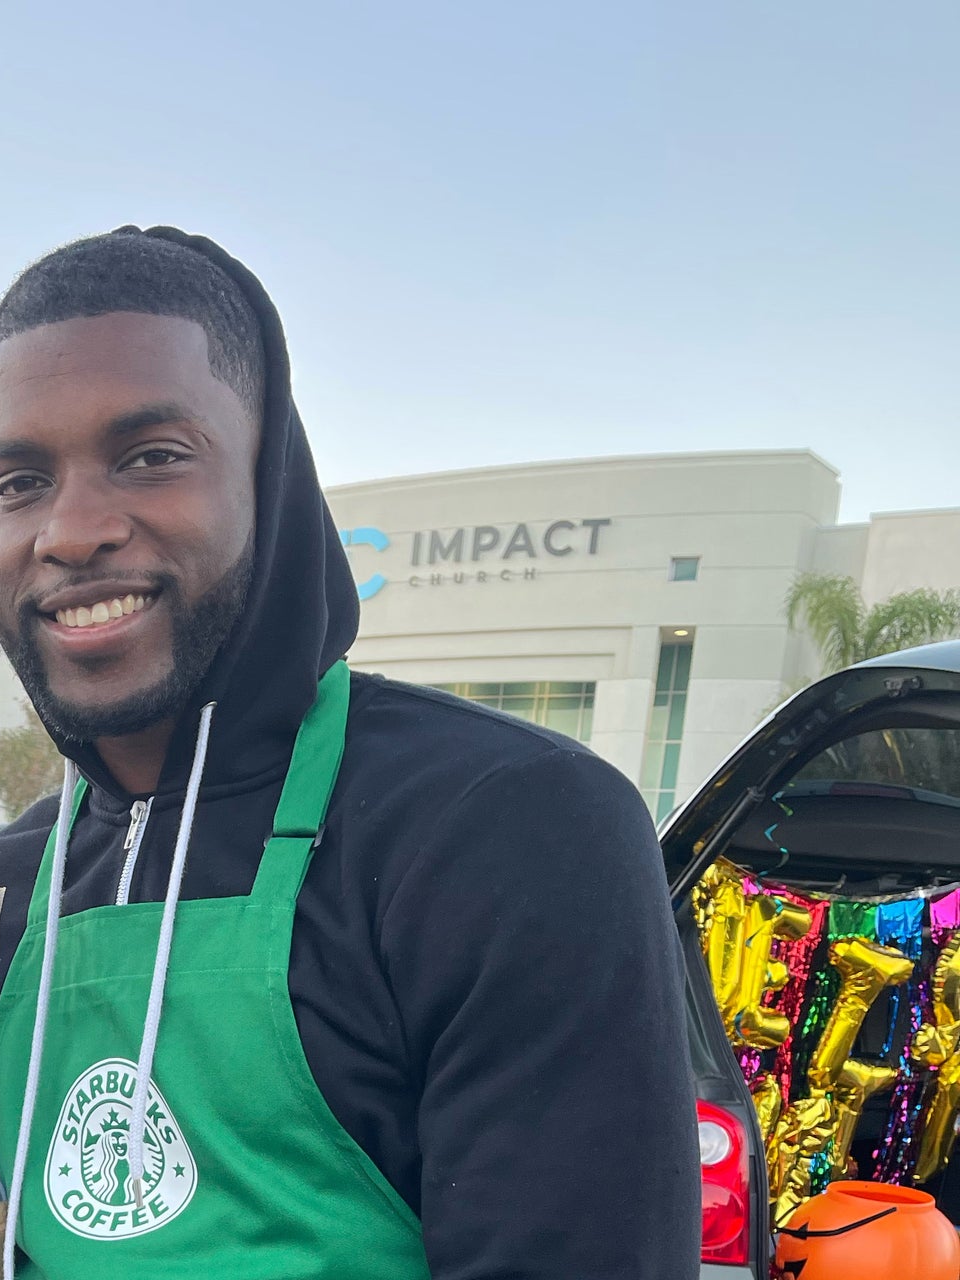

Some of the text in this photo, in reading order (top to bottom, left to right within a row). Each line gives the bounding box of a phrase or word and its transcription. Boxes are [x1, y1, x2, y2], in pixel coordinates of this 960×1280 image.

[411, 518, 611, 566] IMPACT
[409, 568, 536, 587] CHURCH
[62, 1071, 178, 1146] STARBUKS
[62, 1189, 170, 1232] COFFEE
